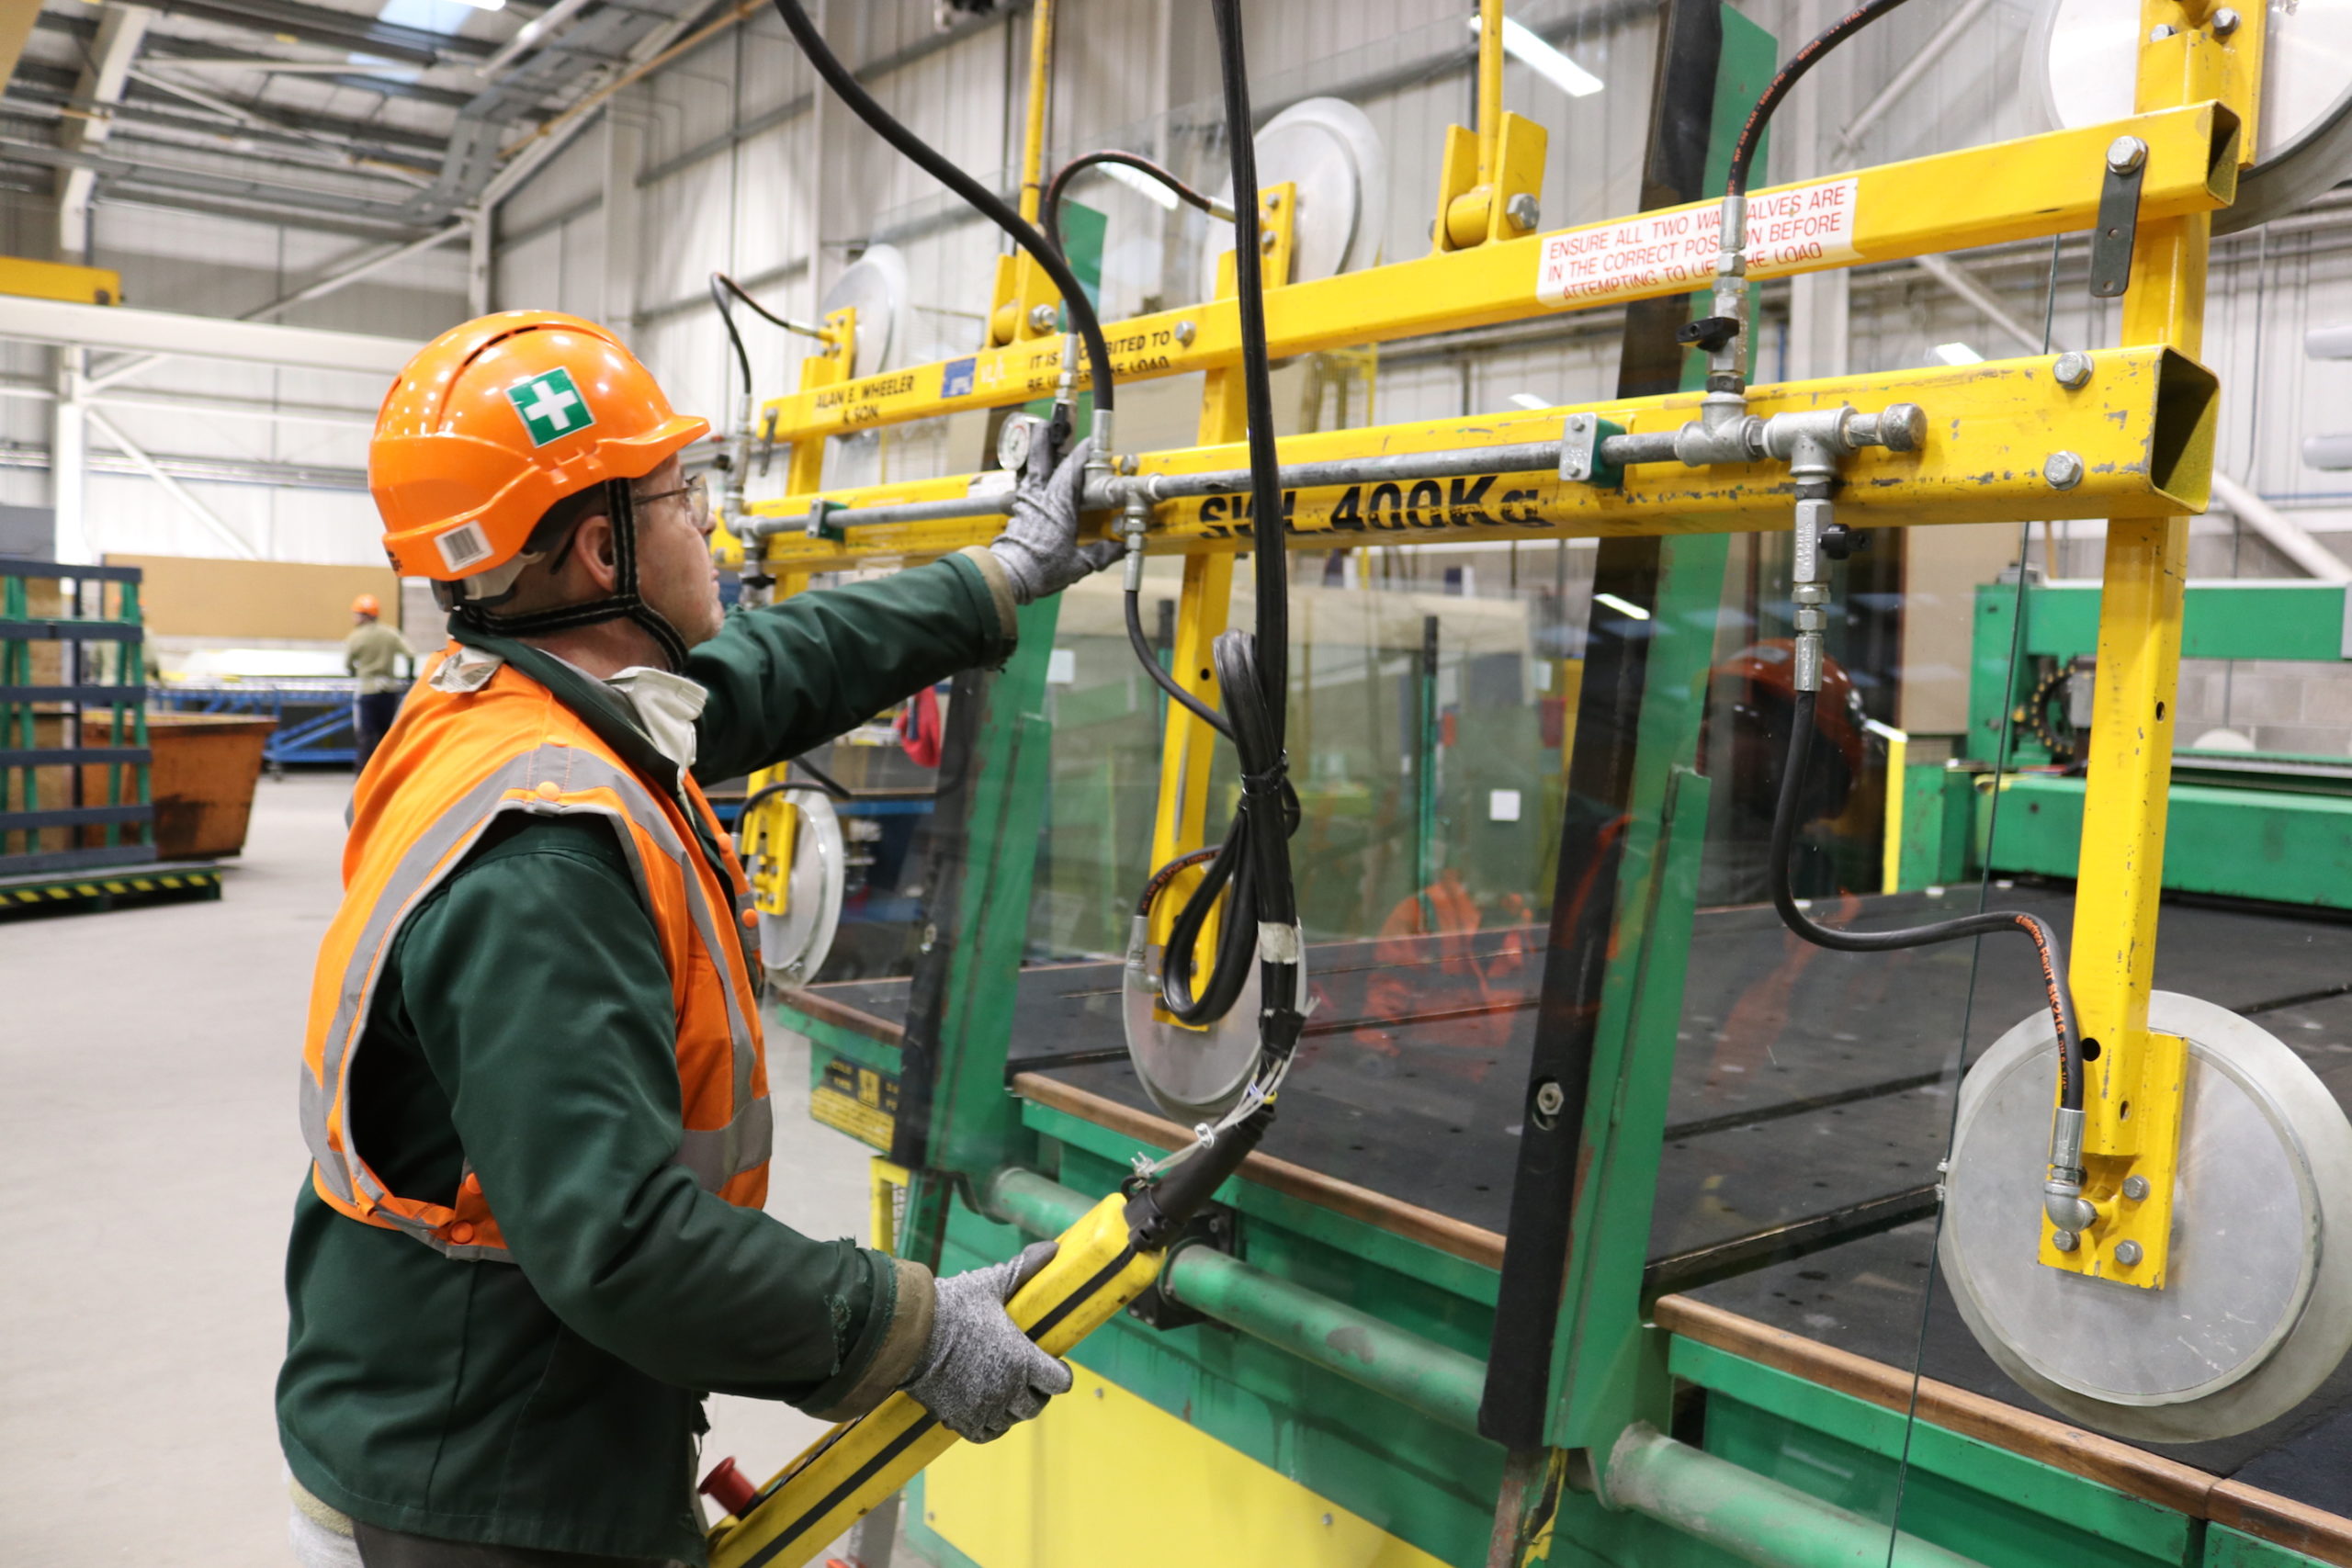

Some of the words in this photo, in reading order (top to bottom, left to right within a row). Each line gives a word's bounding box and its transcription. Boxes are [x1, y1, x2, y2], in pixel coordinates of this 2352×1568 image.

[1547, 265, 1562, 282] IN
[1568, 256, 1598, 278] THE
[1602, 242, 1679, 273] CORRECT
[1684, 227, 1762, 257] POSN
[1770, 211, 1842, 243] BEFORE
[1550, 231, 1609, 260] ENSURE
[1615, 226, 1643, 246] ALL
[1651, 216, 1689, 239] TWO
[1697, 210, 1721, 231] WA
[1746, 195, 1802, 220] ALVES
[1808, 186, 1846, 210] ARE
[1562, 269, 1659, 300] ATTEMPTING
[1662, 265, 1687, 283] TO
[1691, 258, 1719, 278] LIF
[1745, 251, 1770, 270] HE
[1774, 243, 1822, 265] LOAD
[1027, 377, 1044, 392] BE
[1130, 355, 1170, 374] LOAD
[1030, 355, 1044, 370] IT
[1046, 352, 1058, 367] IS
[1152, 331, 1170, 348] TO
[815, 390, 844, 409] ALAN
[861, 375, 915, 399] WHEELER
[855, 404, 879, 423] SON
[1330, 475, 1555, 531] 400Kg
[2045, 984, 2066, 1034] SK216
